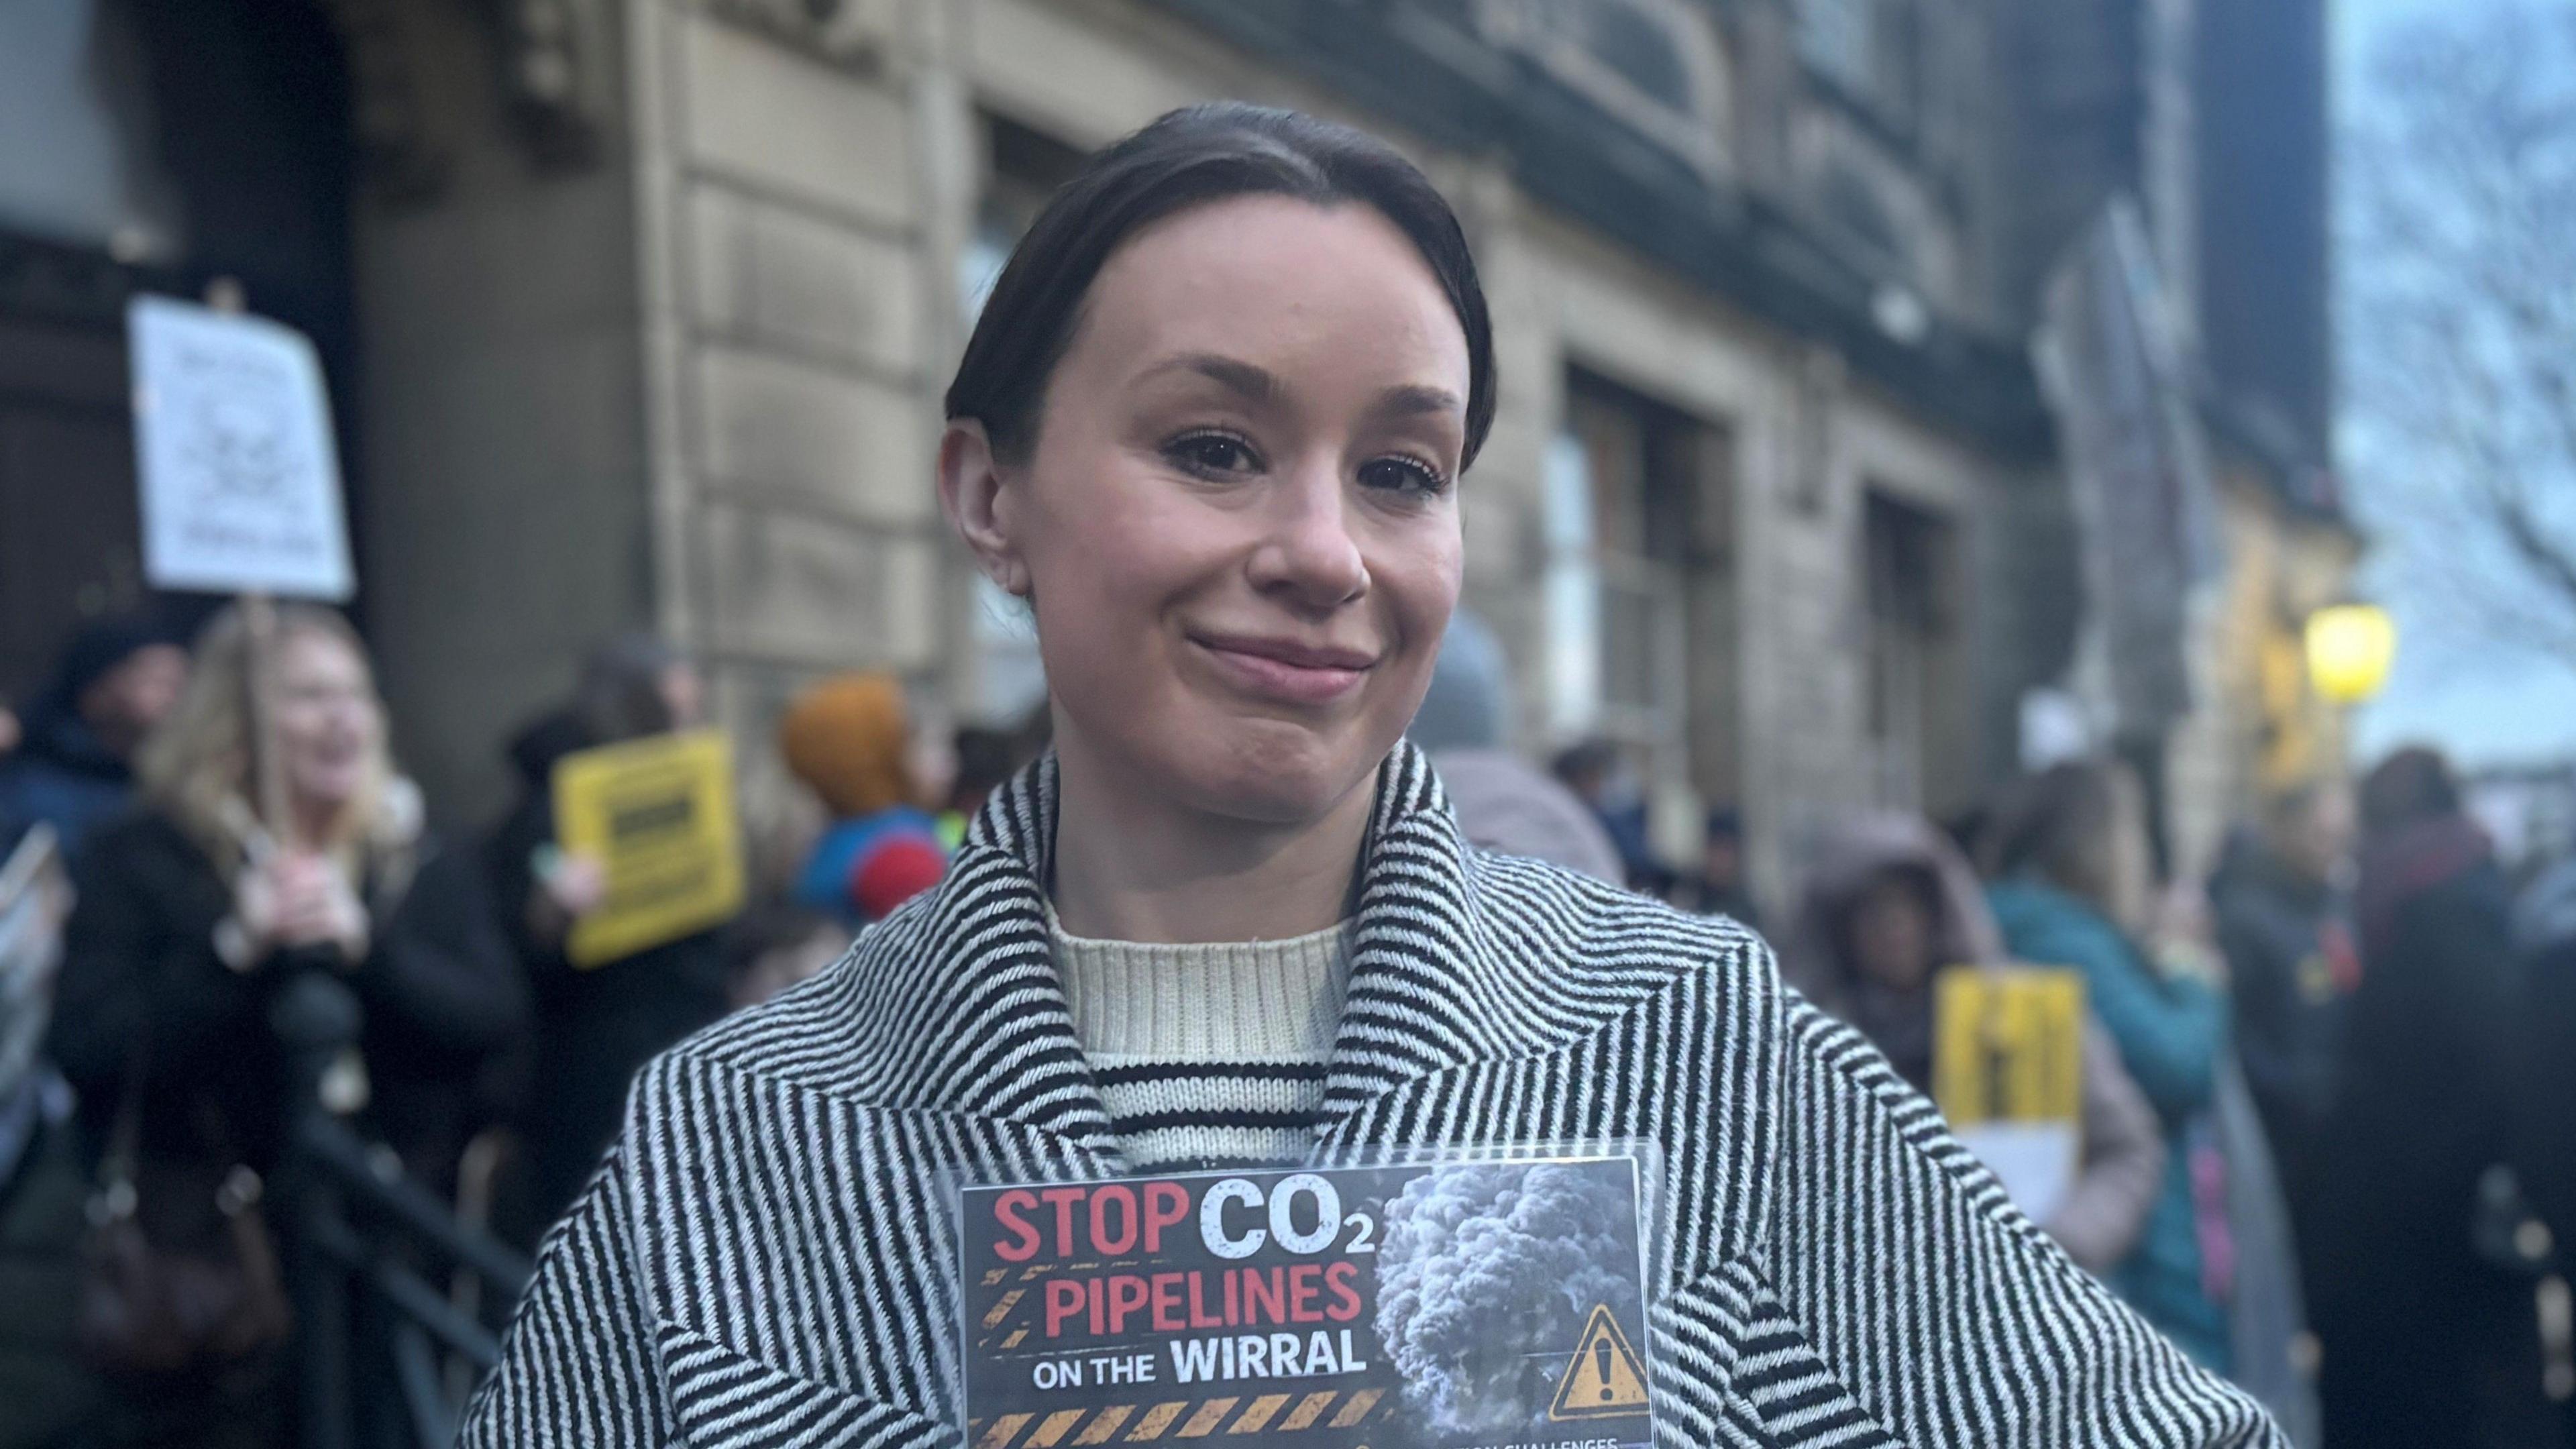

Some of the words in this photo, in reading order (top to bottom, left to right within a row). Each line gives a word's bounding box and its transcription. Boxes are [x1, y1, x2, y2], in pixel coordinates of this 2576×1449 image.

[994, 1181, 1190, 1261] STOP
[1045, 1262, 1361, 1337] PIPELINES
[1033, 1360, 1081, 1389] ON
[1089, 1354, 1156, 1385] THE
[1169, 1329, 1367, 1383] WIRRAL
[1504, 1438, 1618, 1449] ENGES
